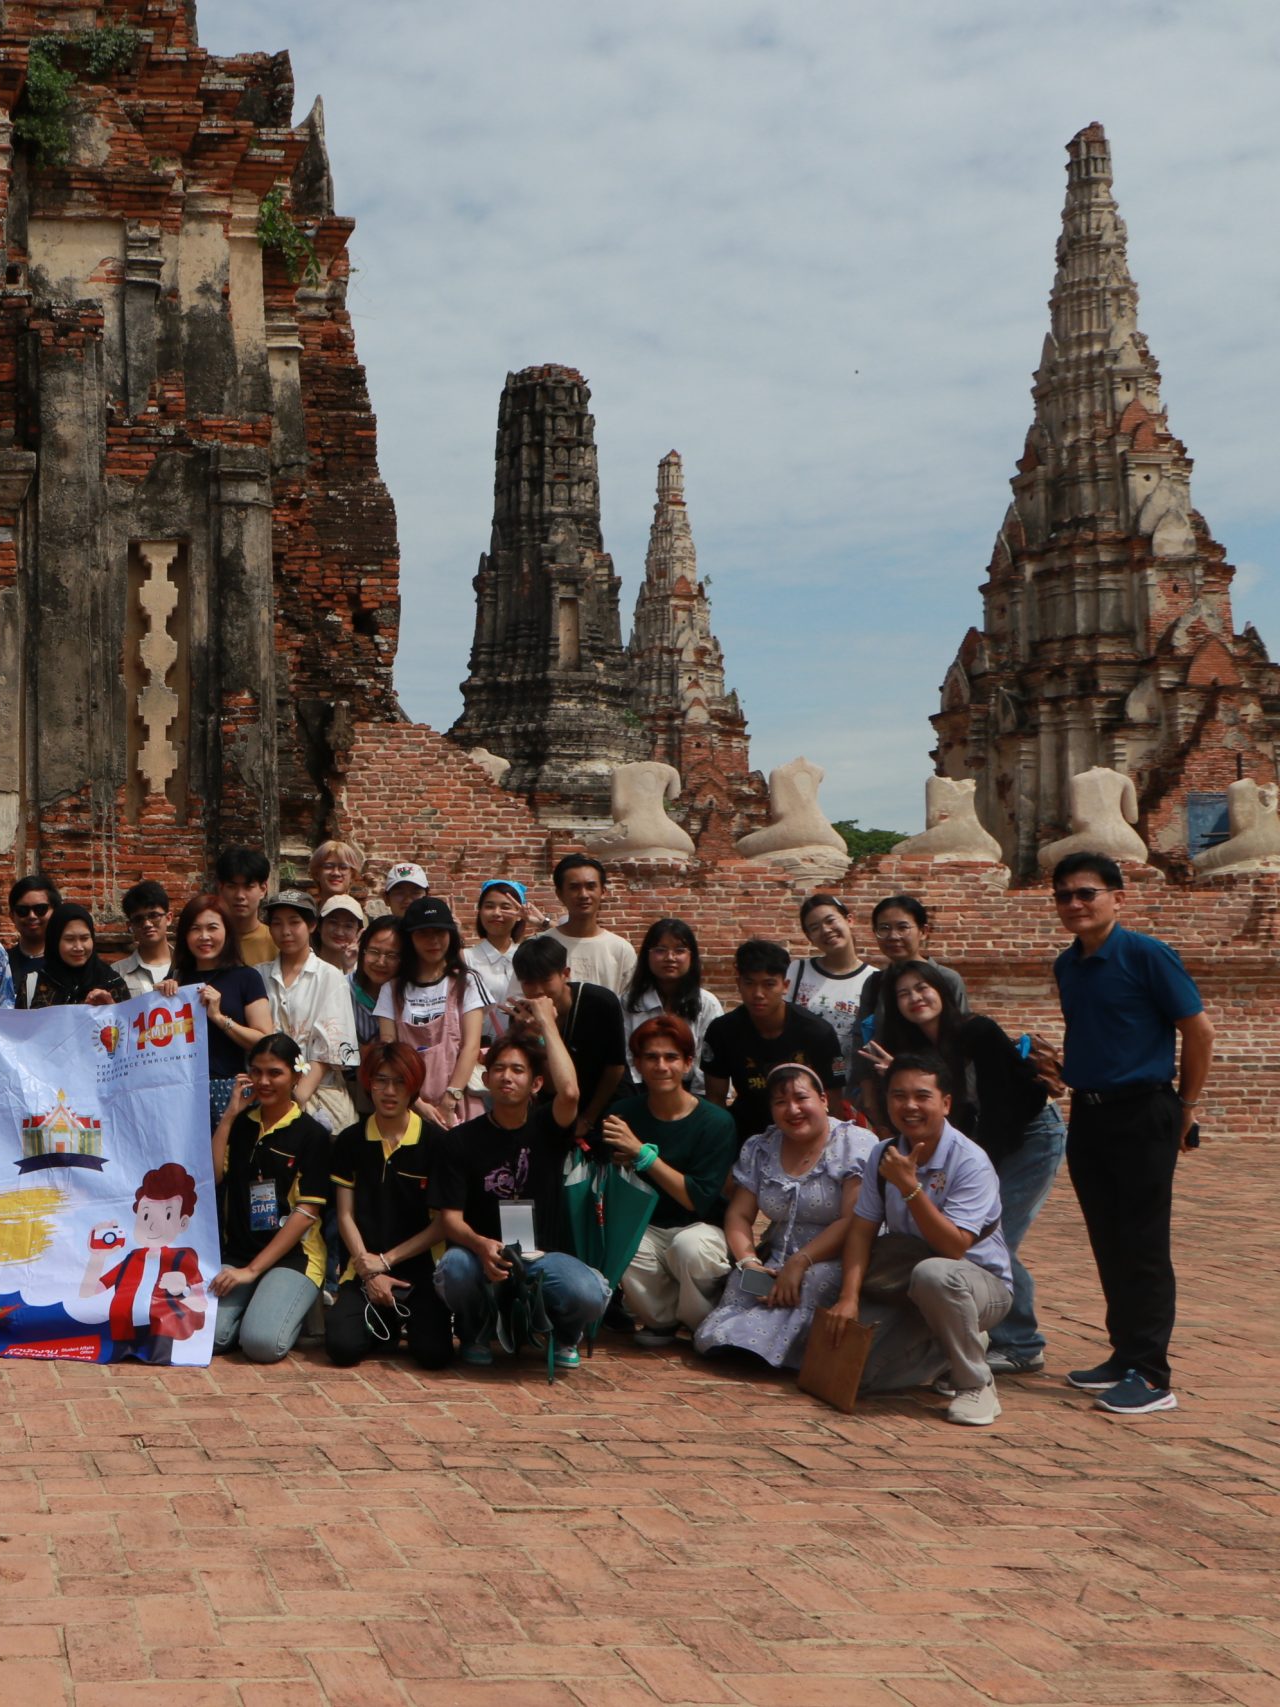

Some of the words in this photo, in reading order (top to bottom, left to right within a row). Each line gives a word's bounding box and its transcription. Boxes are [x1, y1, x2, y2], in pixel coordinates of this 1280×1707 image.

[132, 1003, 195, 1050] 101
[142, 1052, 198, 1066] ENRICHMENT
[251, 1203, 276, 1214] STAFF
